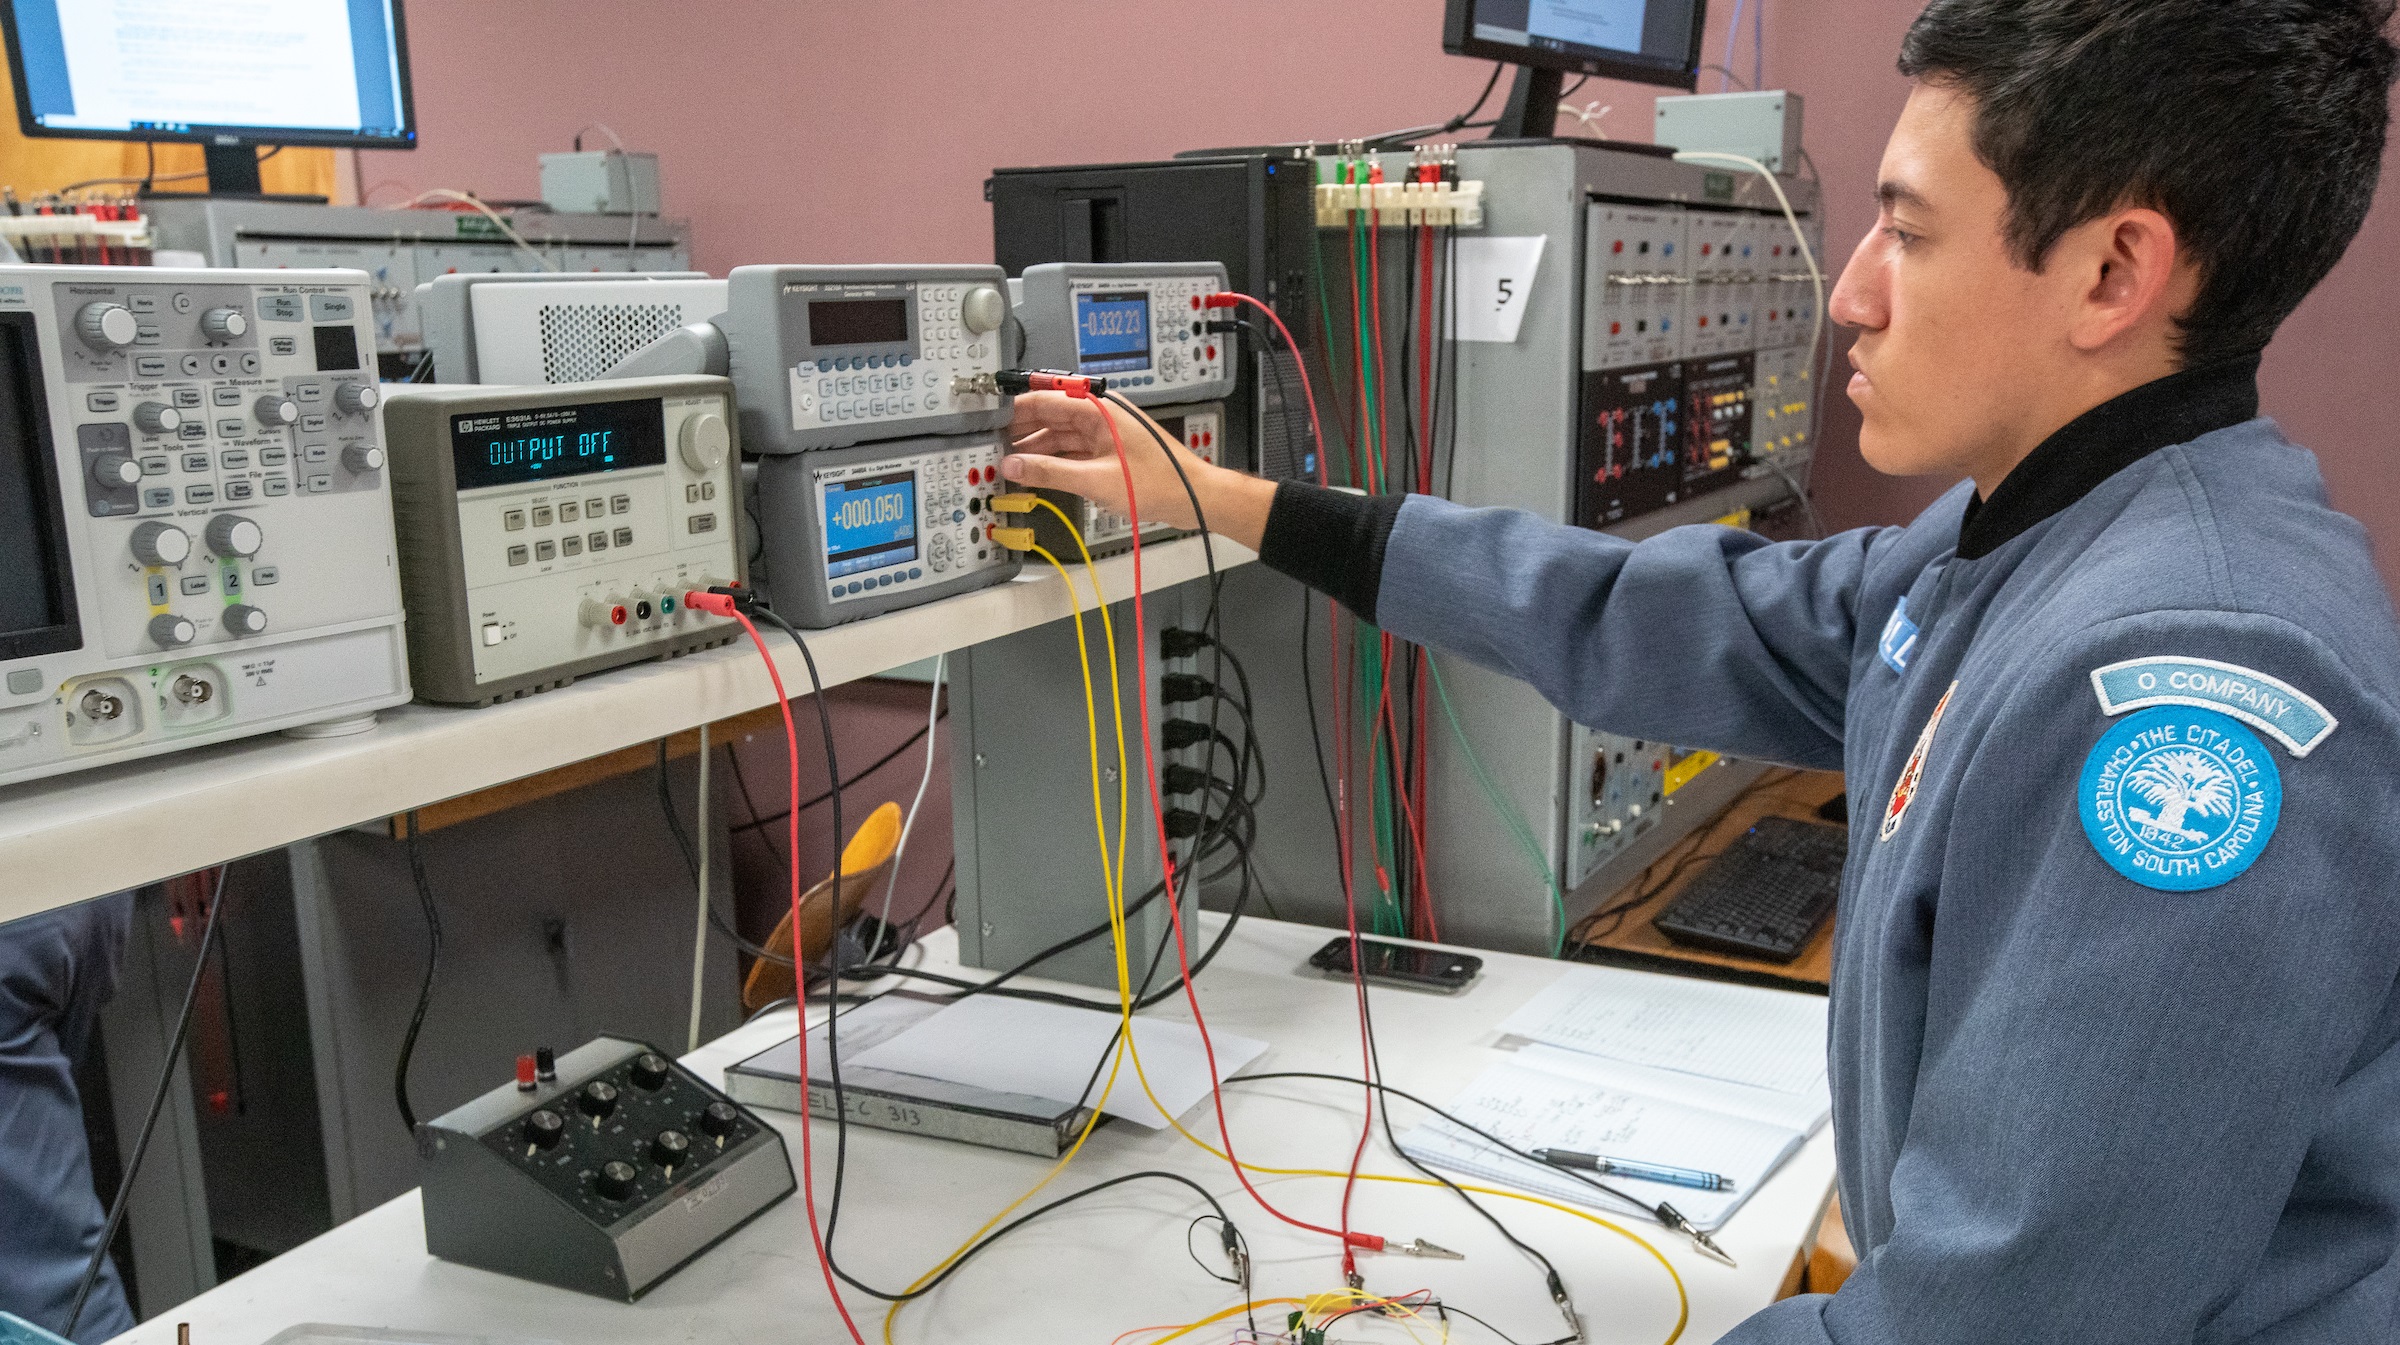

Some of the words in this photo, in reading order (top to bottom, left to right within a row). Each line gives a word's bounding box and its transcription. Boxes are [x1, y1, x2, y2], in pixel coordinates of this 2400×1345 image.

[69, 286, 116, 295] Horizontal
[282, 286, 298, 294] Run
[299, 286, 326, 294] Control
[1497, 278, 1513, 305] 5
[324, 302, 346, 311] Single
[276, 309, 294, 317] Stop
[129, 382, 158, 391] Trigger
[229, 378, 263, 386] Measure
[473, 417, 500, 425] HEWLETT
[474, 424, 501, 432] PACKARD
[233, 438, 272, 447] Waveform
[489, 435, 564, 466] OUTPUT
[579, 430, 613, 457] OFF
[249, 471, 263, 479] File
[823, 469, 846, 479] KEYSIGHT
[553, 482, 579, 490] FUNCTION
[177, 508, 209, 517] Vertical
[832, 493, 904, 530] +000.050
[229, 574, 238, 588] 2
[156, 583, 164, 597] 1
[151, 668, 158, 676] 2
[2138, 672, 2156, 690] O
[2168, 670, 2292, 719] COMPANY
[56, 697, 63, 705] X
[2136, 724, 2178, 749] THE
[2187, 724, 2260, 784] CITADEL
[2095, 745, 2134, 856] CHARLESTON
[2132, 849, 2201, 877] SOUTH
[2204, 789, 2265, 869] CAROLINA
[2138, 823, 2188, 851] 1842
[888, 1106, 922, 1127] 313
